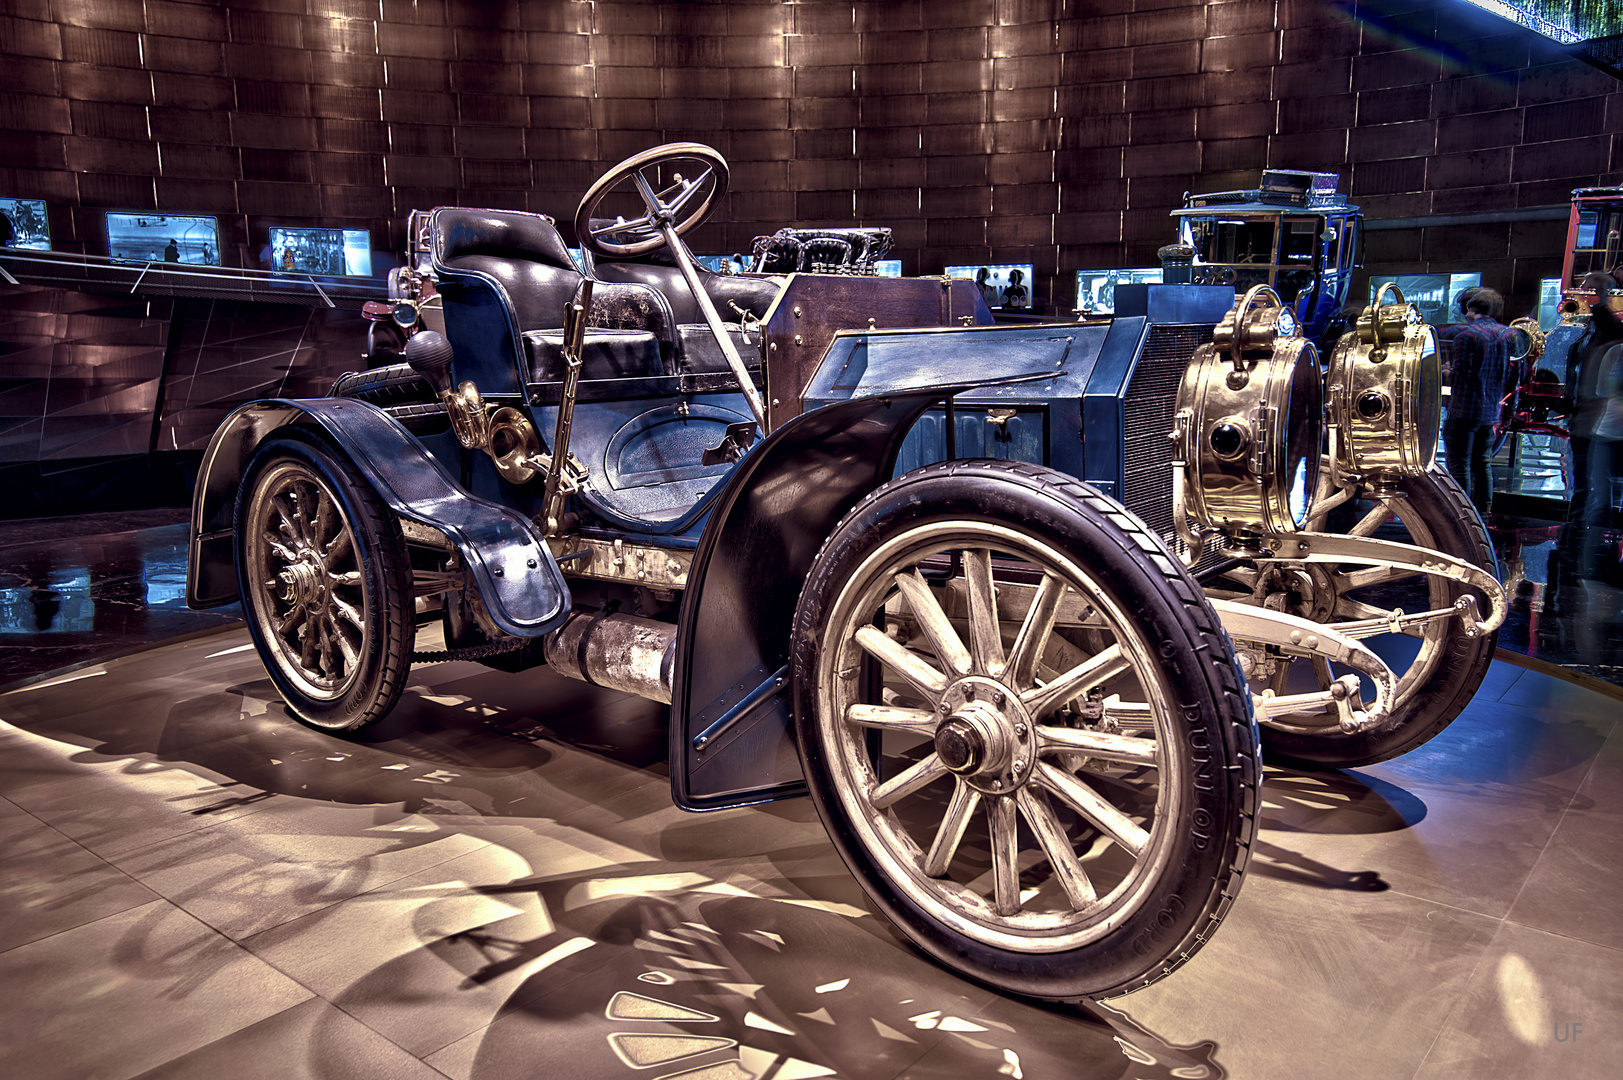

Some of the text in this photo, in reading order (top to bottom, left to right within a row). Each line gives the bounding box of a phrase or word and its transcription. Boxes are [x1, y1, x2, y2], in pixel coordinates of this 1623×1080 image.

[344, 557, 377, 716] DUNLOP CORD
[1131, 700, 1214, 957] DUNLOP CORD
